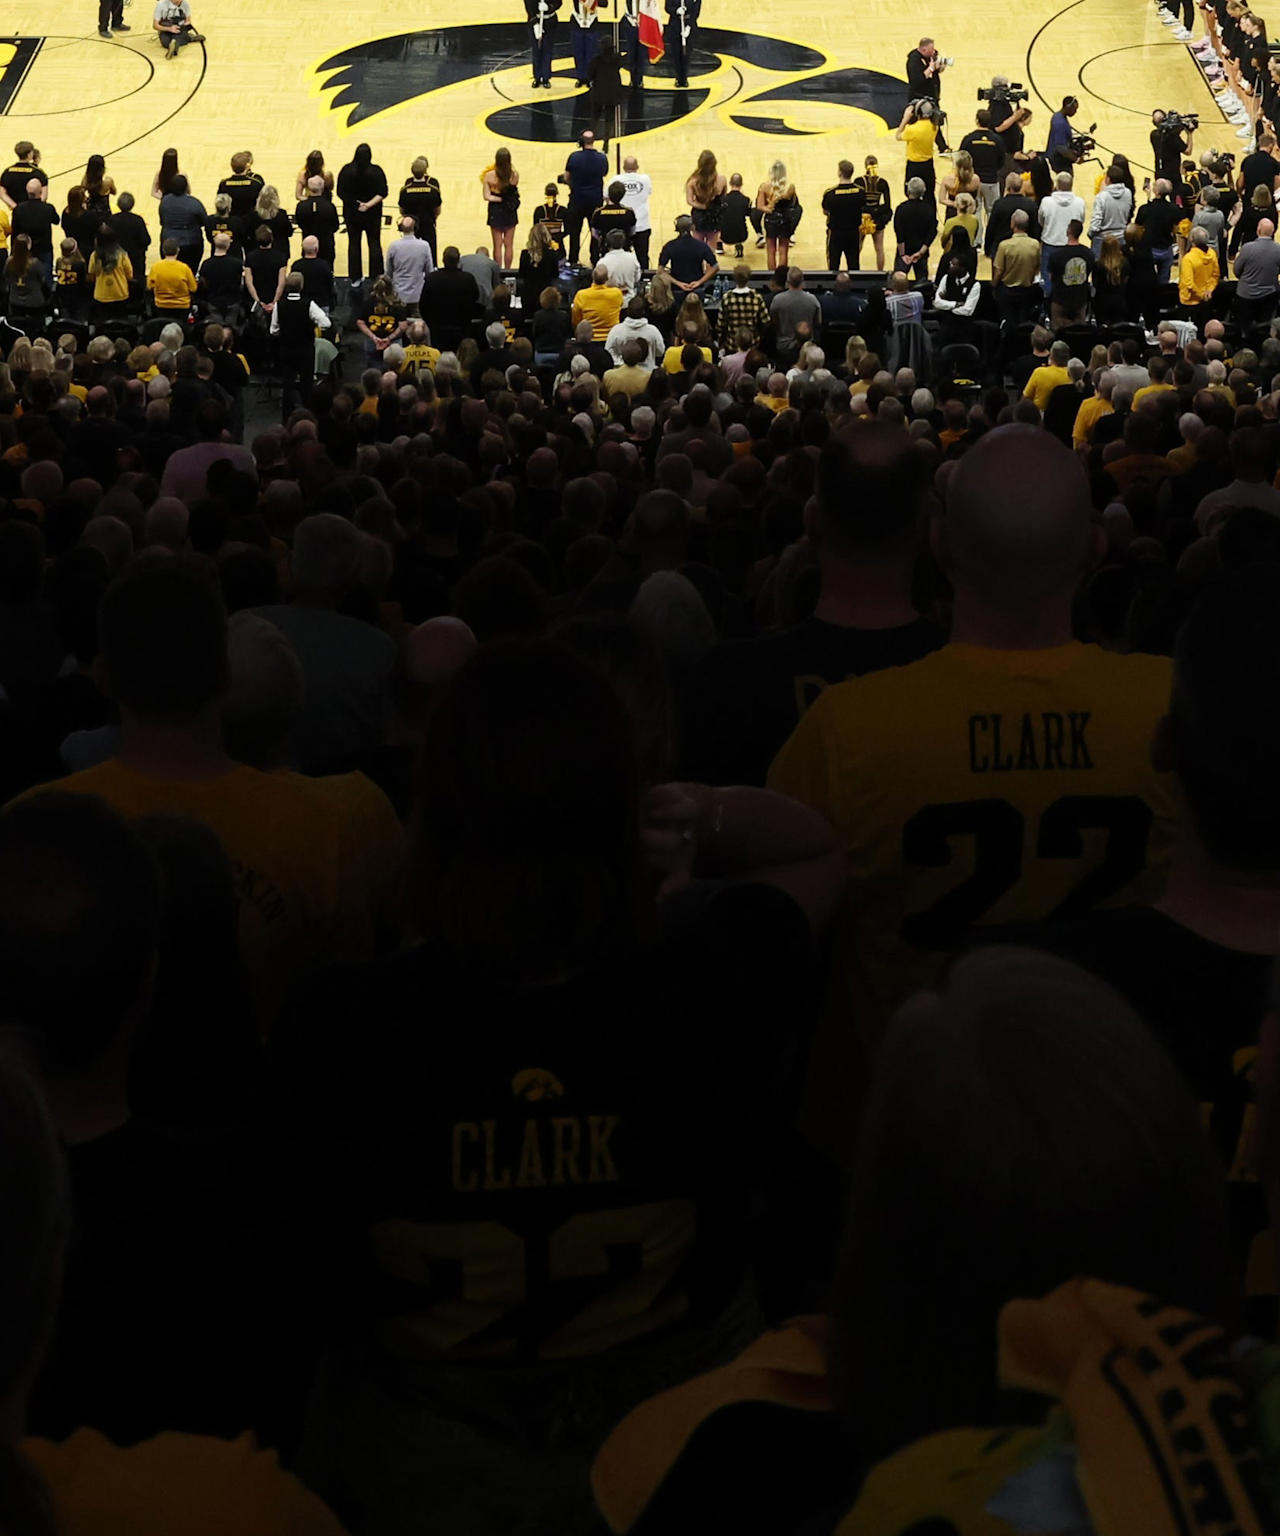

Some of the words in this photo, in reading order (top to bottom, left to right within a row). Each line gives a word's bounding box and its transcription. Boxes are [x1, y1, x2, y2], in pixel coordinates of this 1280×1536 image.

[968, 712, 1094, 773] CLARK
[902, 796, 1153, 947] 22
[450, 1113, 623, 1192] CLARK
[369, 1196, 697, 1361] 22
